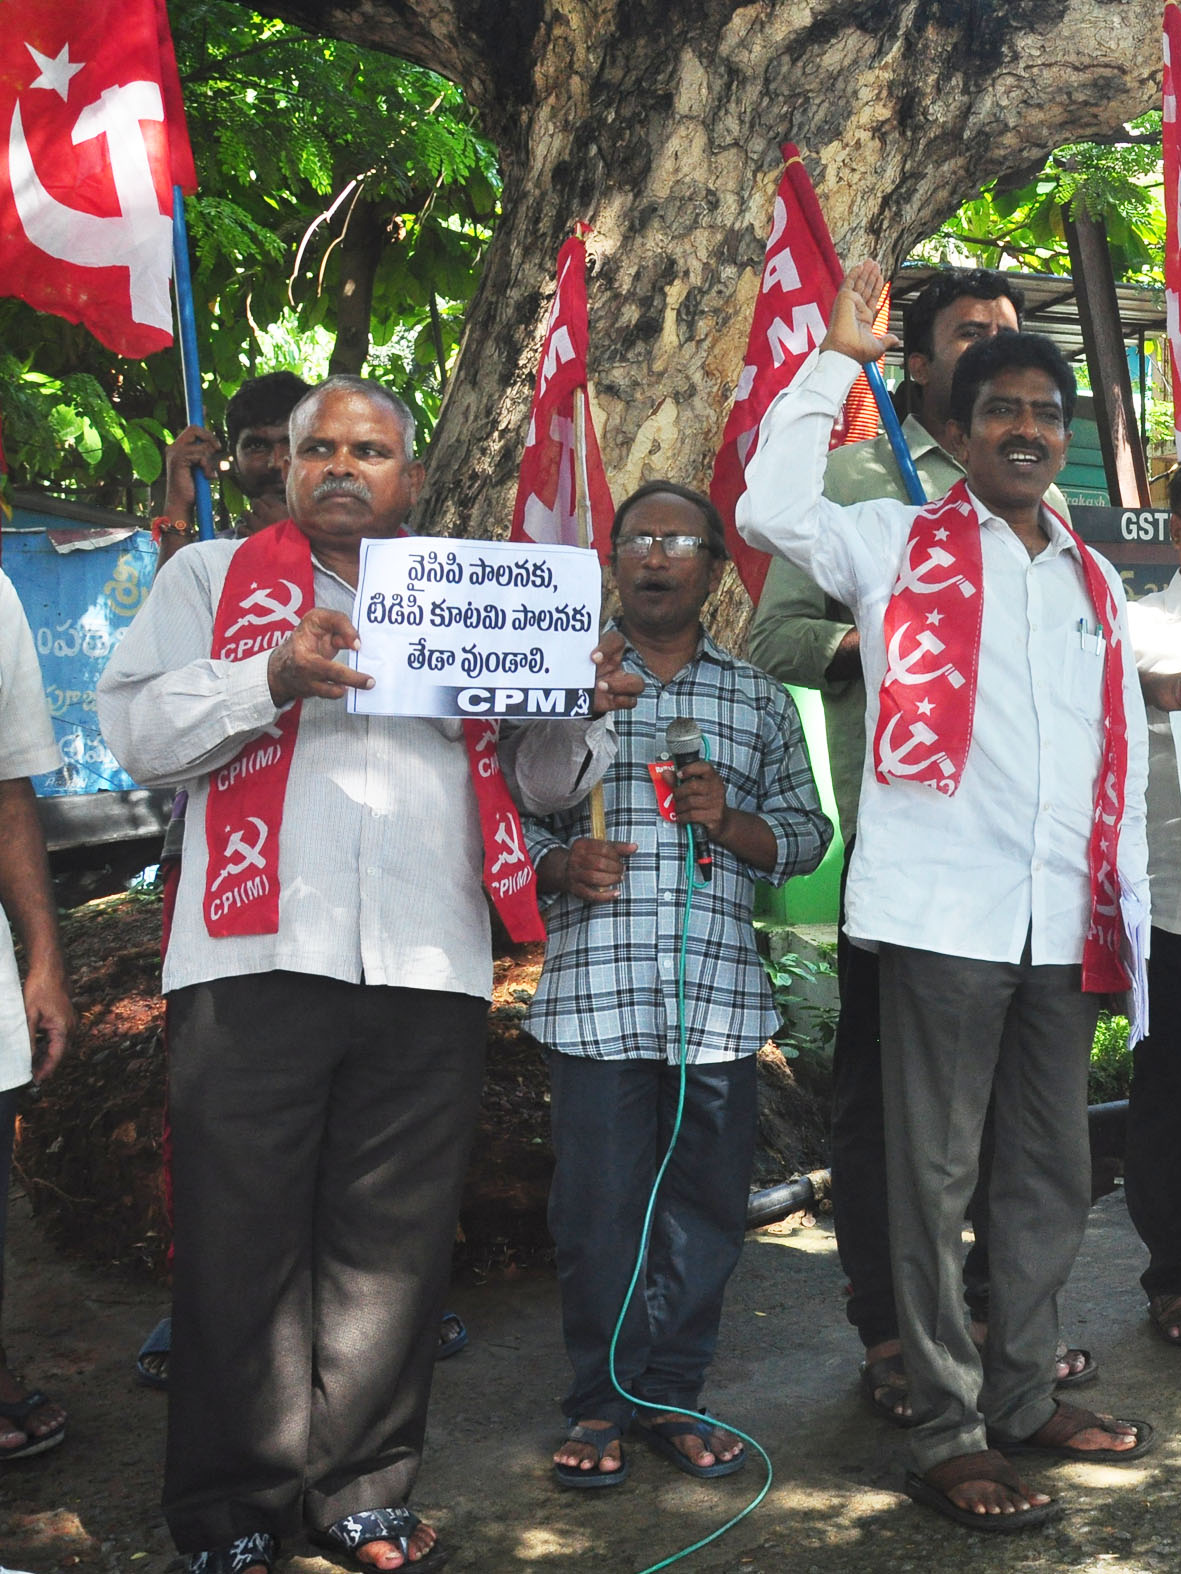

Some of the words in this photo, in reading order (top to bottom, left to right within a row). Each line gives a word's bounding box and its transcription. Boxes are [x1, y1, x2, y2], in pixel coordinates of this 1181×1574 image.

[408, 551, 463, 592] వైసిపి
[469, 557, 558, 593] పాలనకు,
[367, 592, 424, 626] టిడిపి
[430, 598, 506, 630] కూటమి
[512, 603, 592, 632] పాలనకు
[221, 630, 293, 661] CPI(M
[407, 637, 456, 671] తేడా
[460, 643, 550, 679] వుండాలి.
[457, 688, 566, 713] CPM
[217, 744, 282, 791] CPI(M)
[210, 874, 269, 921] CPI(M)
